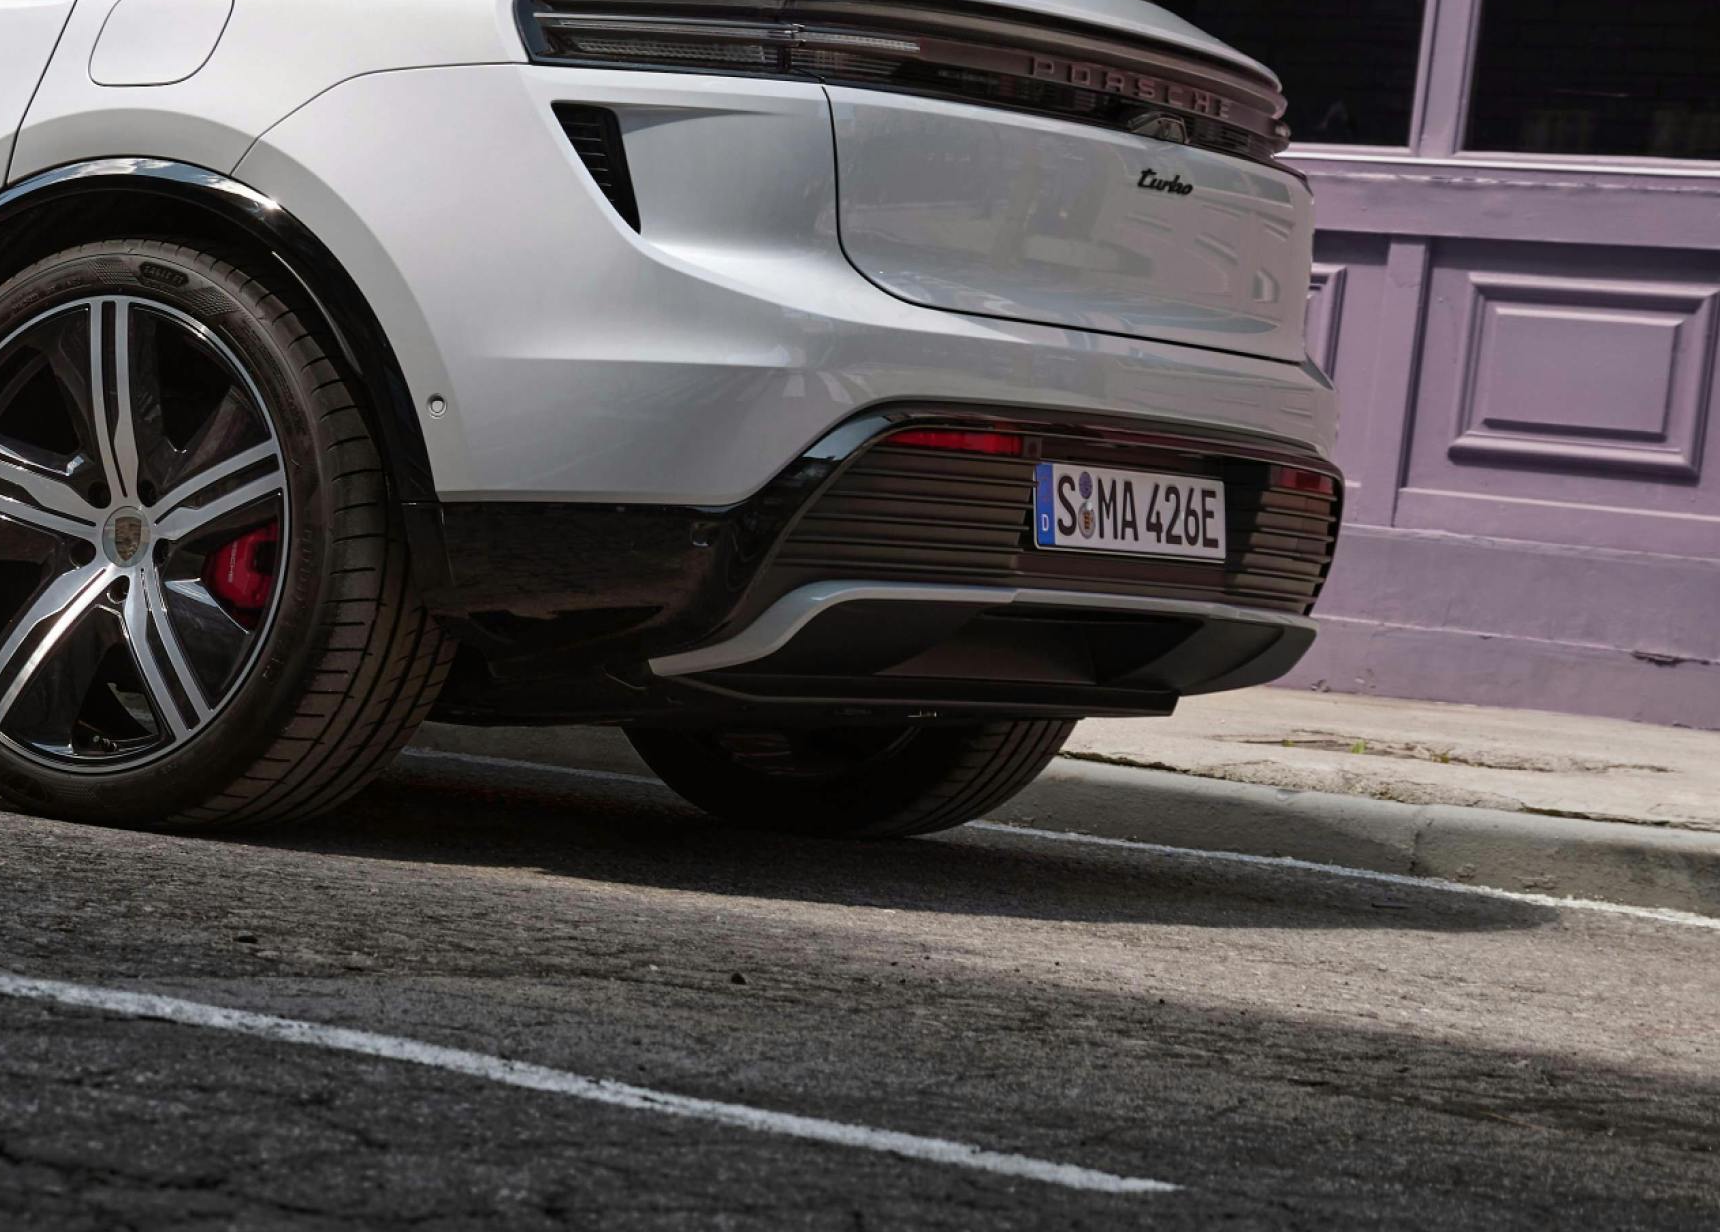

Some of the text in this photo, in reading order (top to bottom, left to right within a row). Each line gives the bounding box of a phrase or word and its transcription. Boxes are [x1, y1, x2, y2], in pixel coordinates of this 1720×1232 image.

[1030, 55, 1232, 118] PORSCHE
[1041, 513, 1049, 532] D
[1146, 483, 1219, 548] 426E
